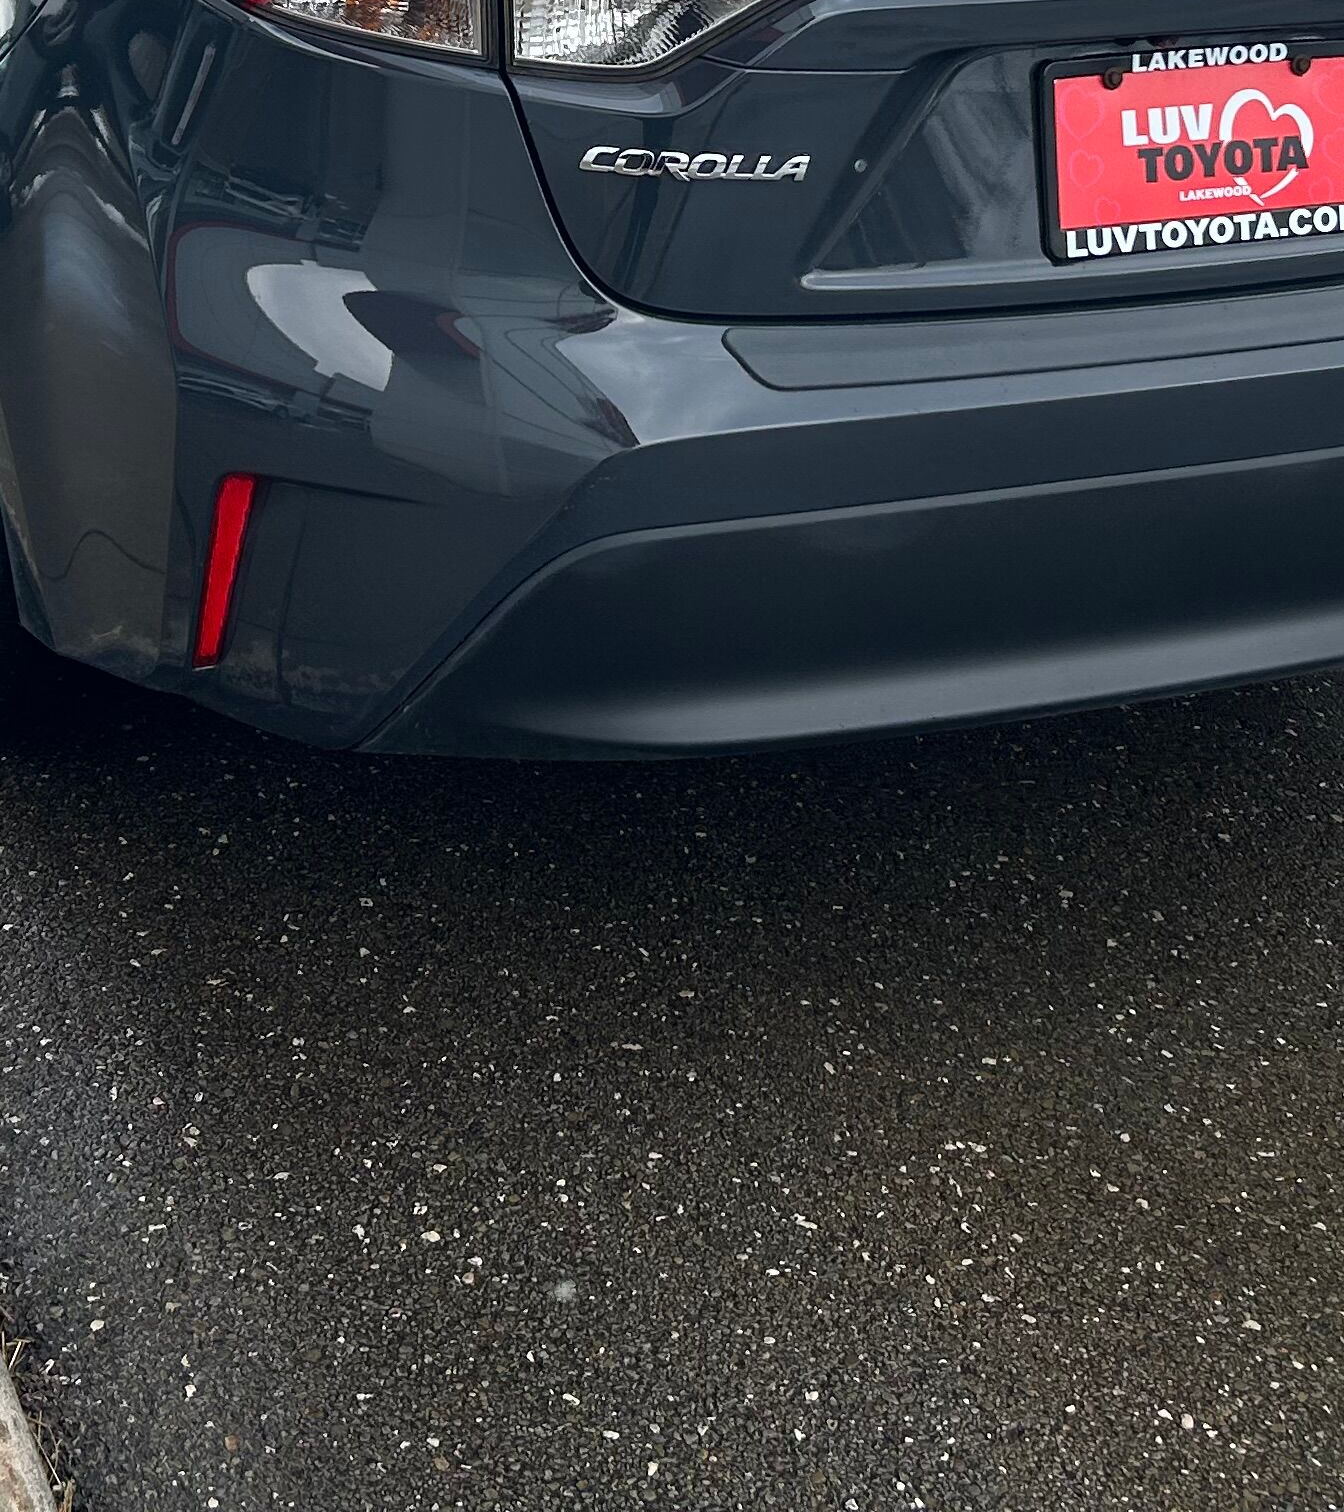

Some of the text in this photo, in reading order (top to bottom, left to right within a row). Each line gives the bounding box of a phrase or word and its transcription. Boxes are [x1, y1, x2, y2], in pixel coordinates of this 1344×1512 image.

[1131, 42, 1288, 73] LAKEWOOD
[1120, 103, 1214, 147] LUV
[579, 145, 811, 182] COROLLA
[1137, 135, 1310, 184] TOYOTA
[1179, 185, 1253, 202] LAKEWOOD
